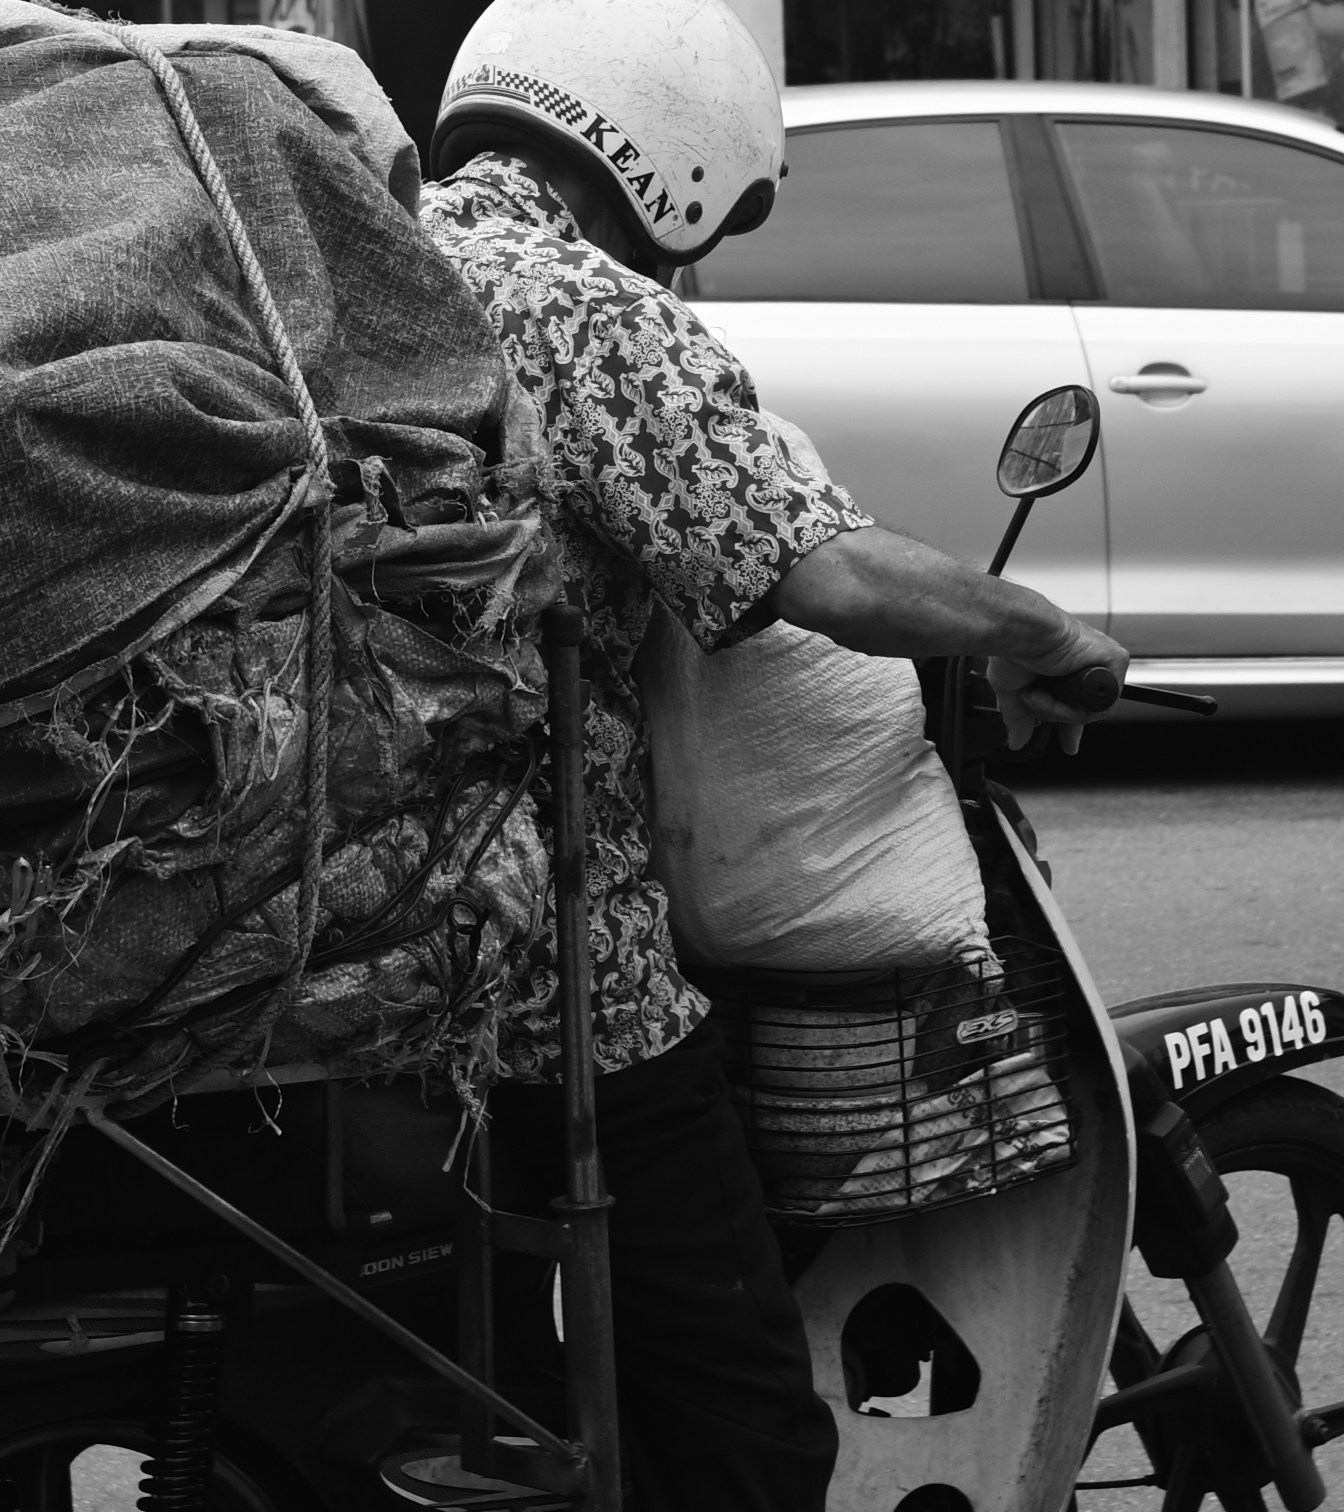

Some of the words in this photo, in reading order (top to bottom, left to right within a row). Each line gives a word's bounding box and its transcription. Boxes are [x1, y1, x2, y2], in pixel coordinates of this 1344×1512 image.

[580, 113, 675, 224] KEAN
[1164, 1017, 1238, 1090] PFA
[1239, 990, 1326, 1063] 9146
[408, 1241, 454, 1265] SIEW
